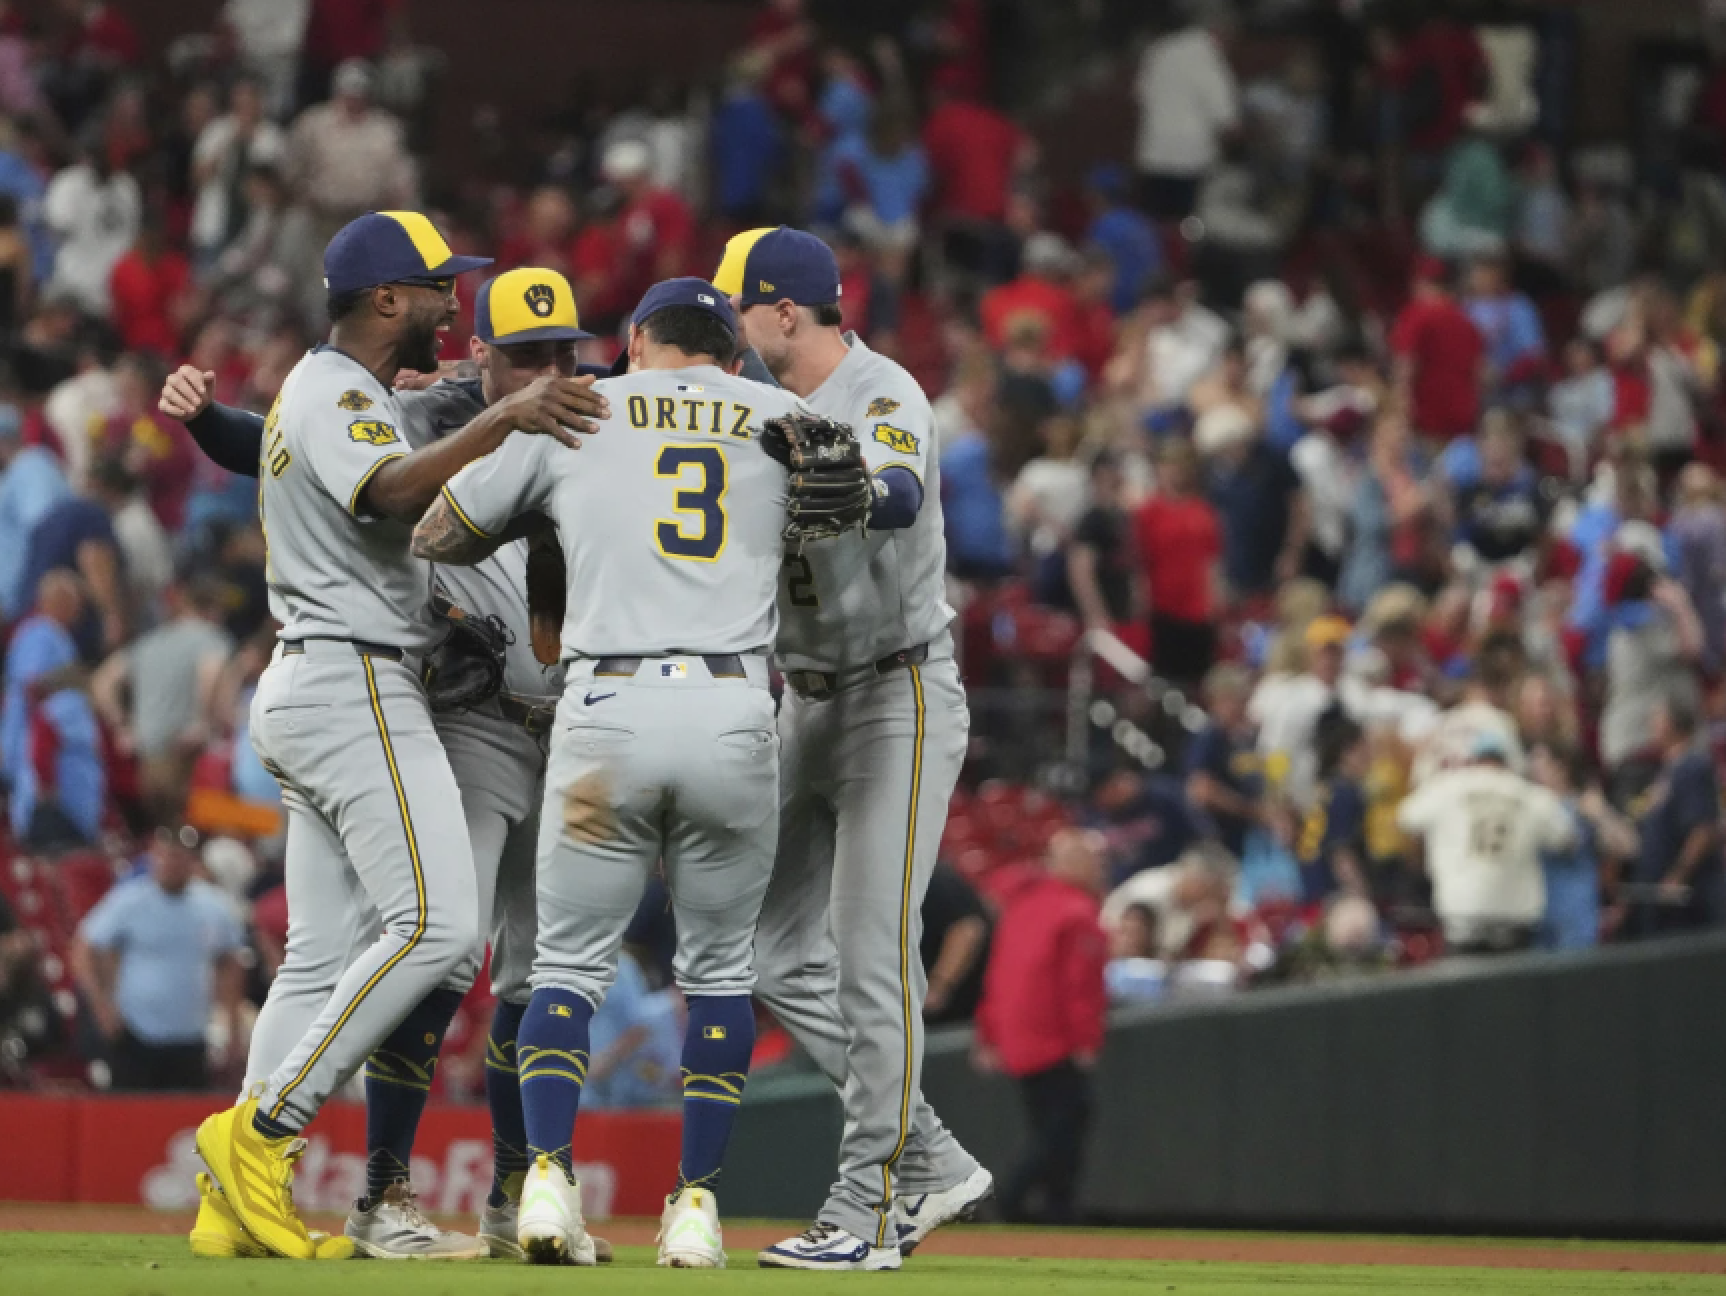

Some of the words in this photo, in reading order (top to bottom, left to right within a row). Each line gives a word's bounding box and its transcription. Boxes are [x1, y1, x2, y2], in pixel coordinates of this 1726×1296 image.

[626, 394, 753, 440] ORTIZ
[654, 442, 730, 563] 3
[783, 552, 819, 607] 2
